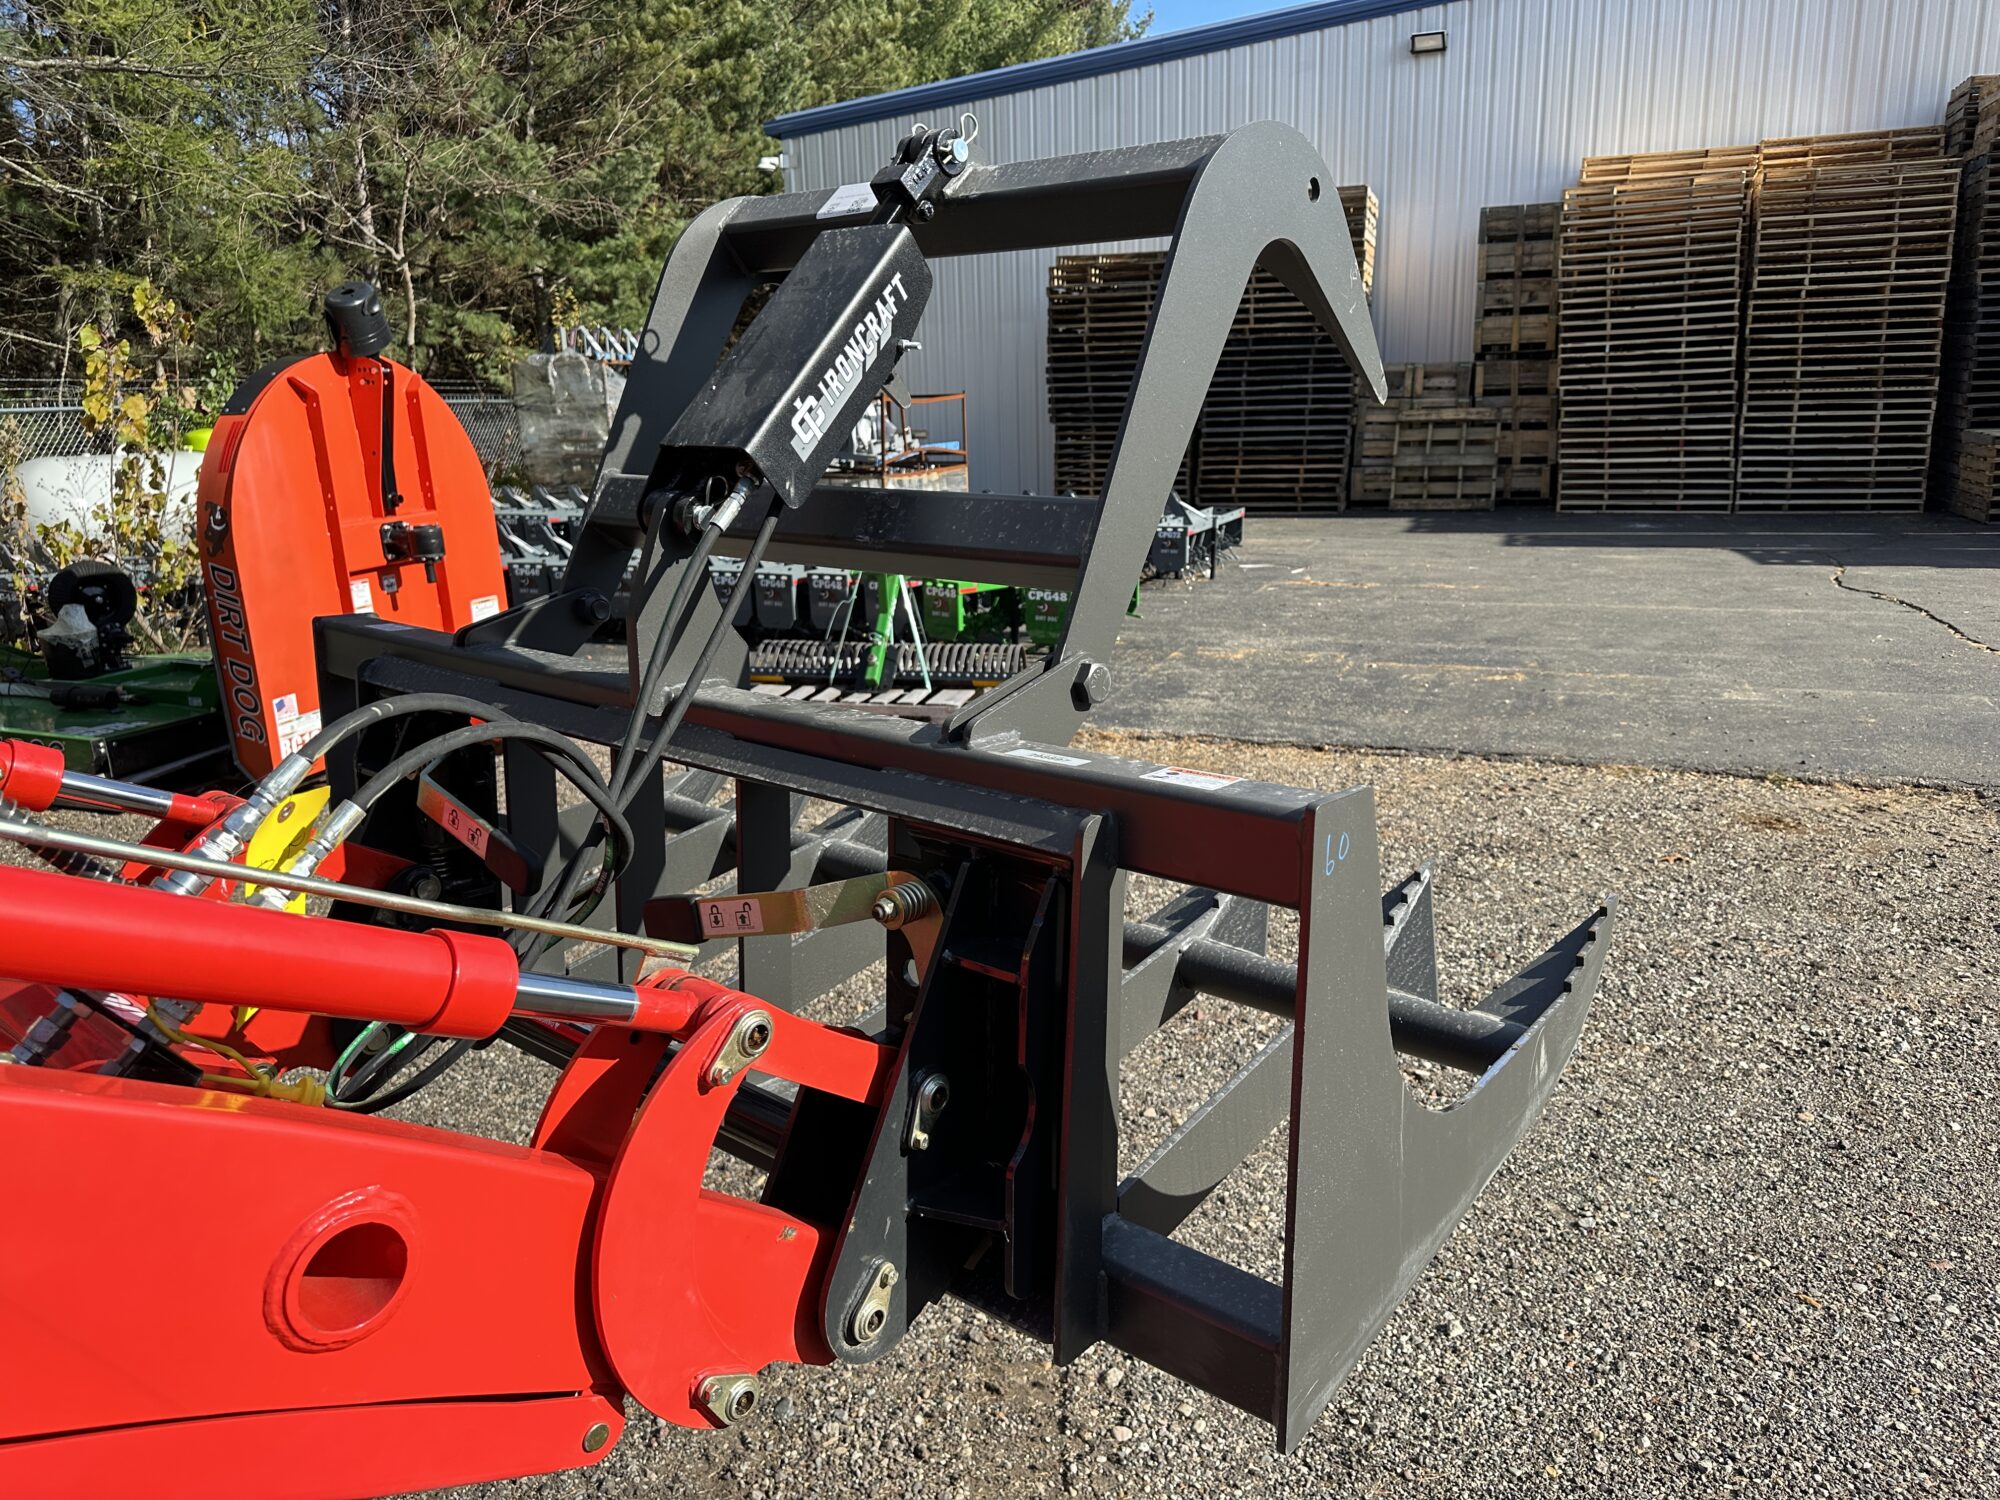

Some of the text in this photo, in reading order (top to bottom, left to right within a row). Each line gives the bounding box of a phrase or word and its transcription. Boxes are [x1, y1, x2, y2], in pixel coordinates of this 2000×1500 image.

[817, 271, 909, 407] IRONCRAFT
[759, 578, 786, 589] CPG48
[812, 578, 843, 590] CPG48
[925, 586, 957, 599] CPG48
[1028, 590, 1068, 602] CPG48
[208, 562, 266, 743] DIRT DOG
[1325, 831, 1350, 876] 60
